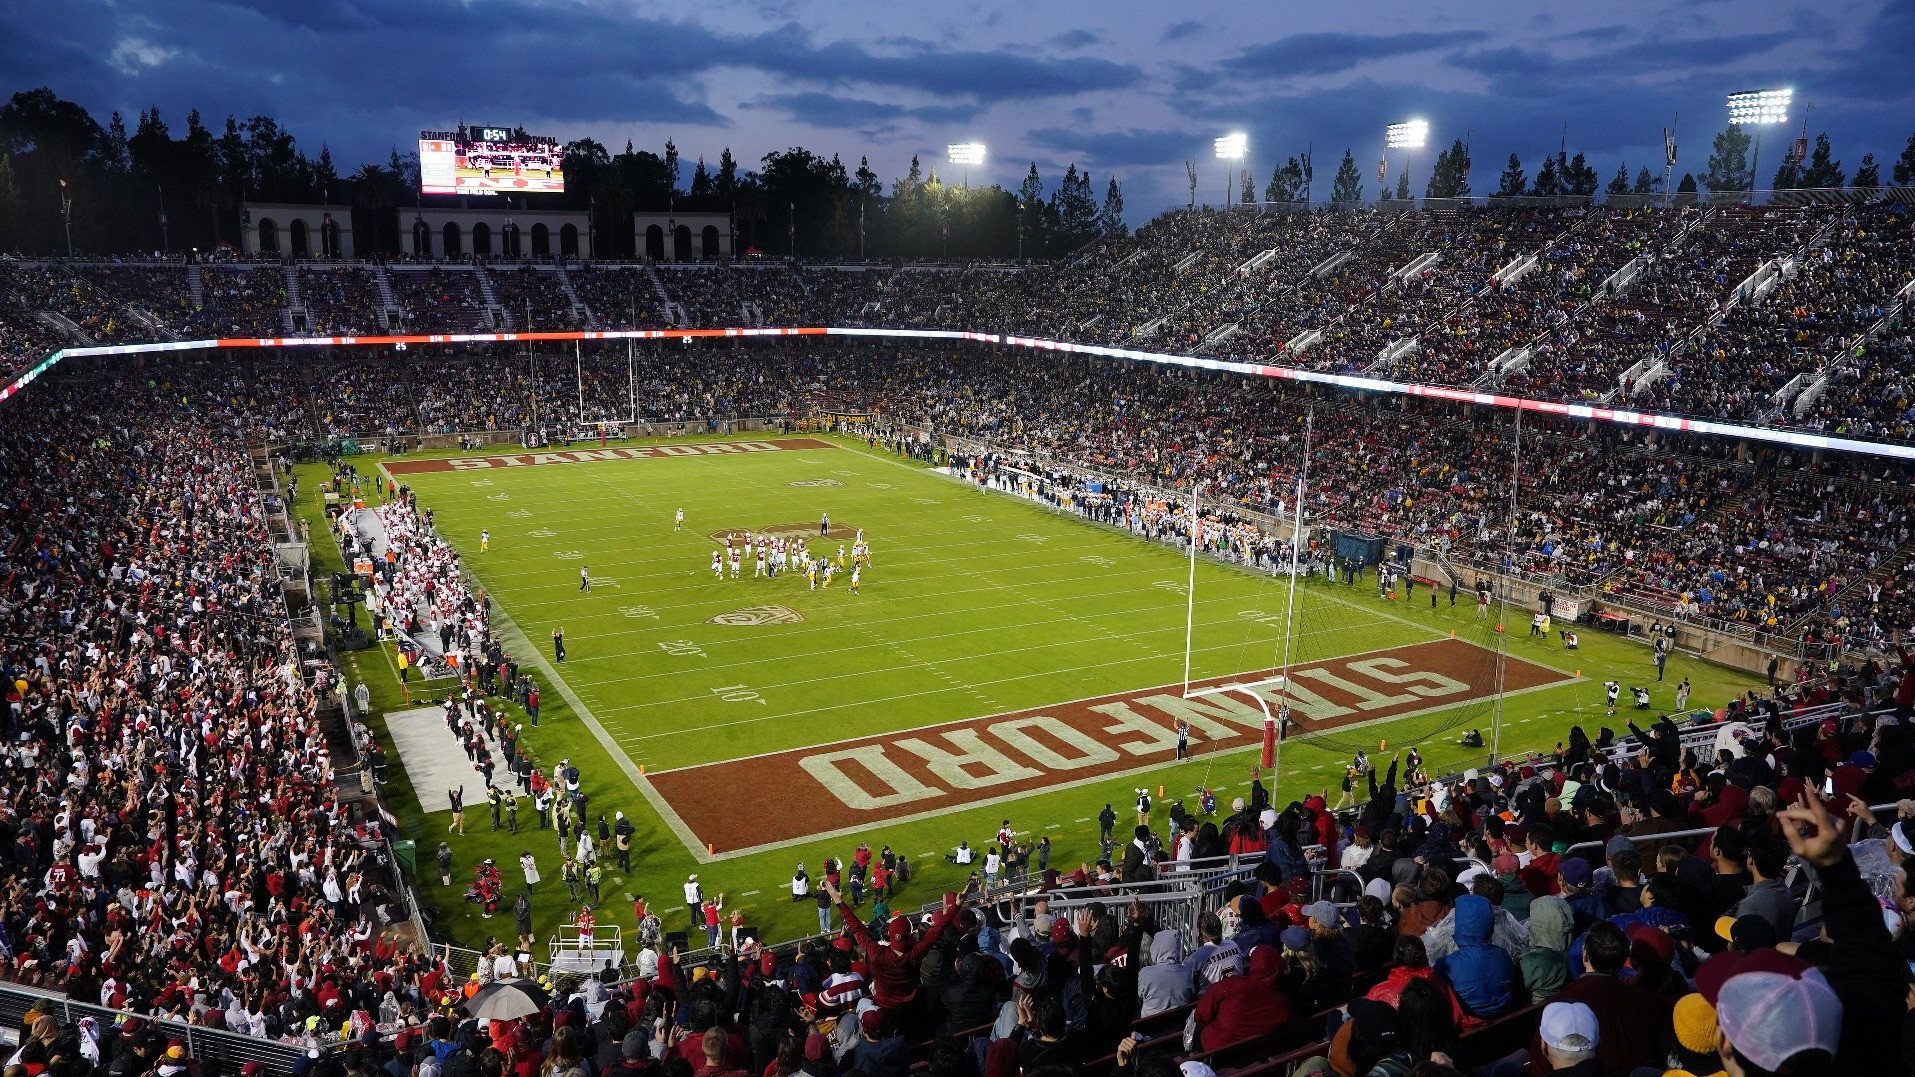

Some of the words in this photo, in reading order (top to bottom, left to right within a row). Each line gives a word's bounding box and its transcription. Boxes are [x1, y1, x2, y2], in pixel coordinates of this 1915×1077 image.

[421, 131, 467, 141] STANFO
[484, 129, 507, 140] 0:54
[683, 335, 692, 344] 25
[395, 342, 407, 350] 25
[448, 441, 783, 471] STANFORD
[710, 684, 760, 702] 10
[798, 657, 1471, 810] STANFORD
[54, 871, 66, 882] 77
[1207, 948, 1239, 964] STANFORD
